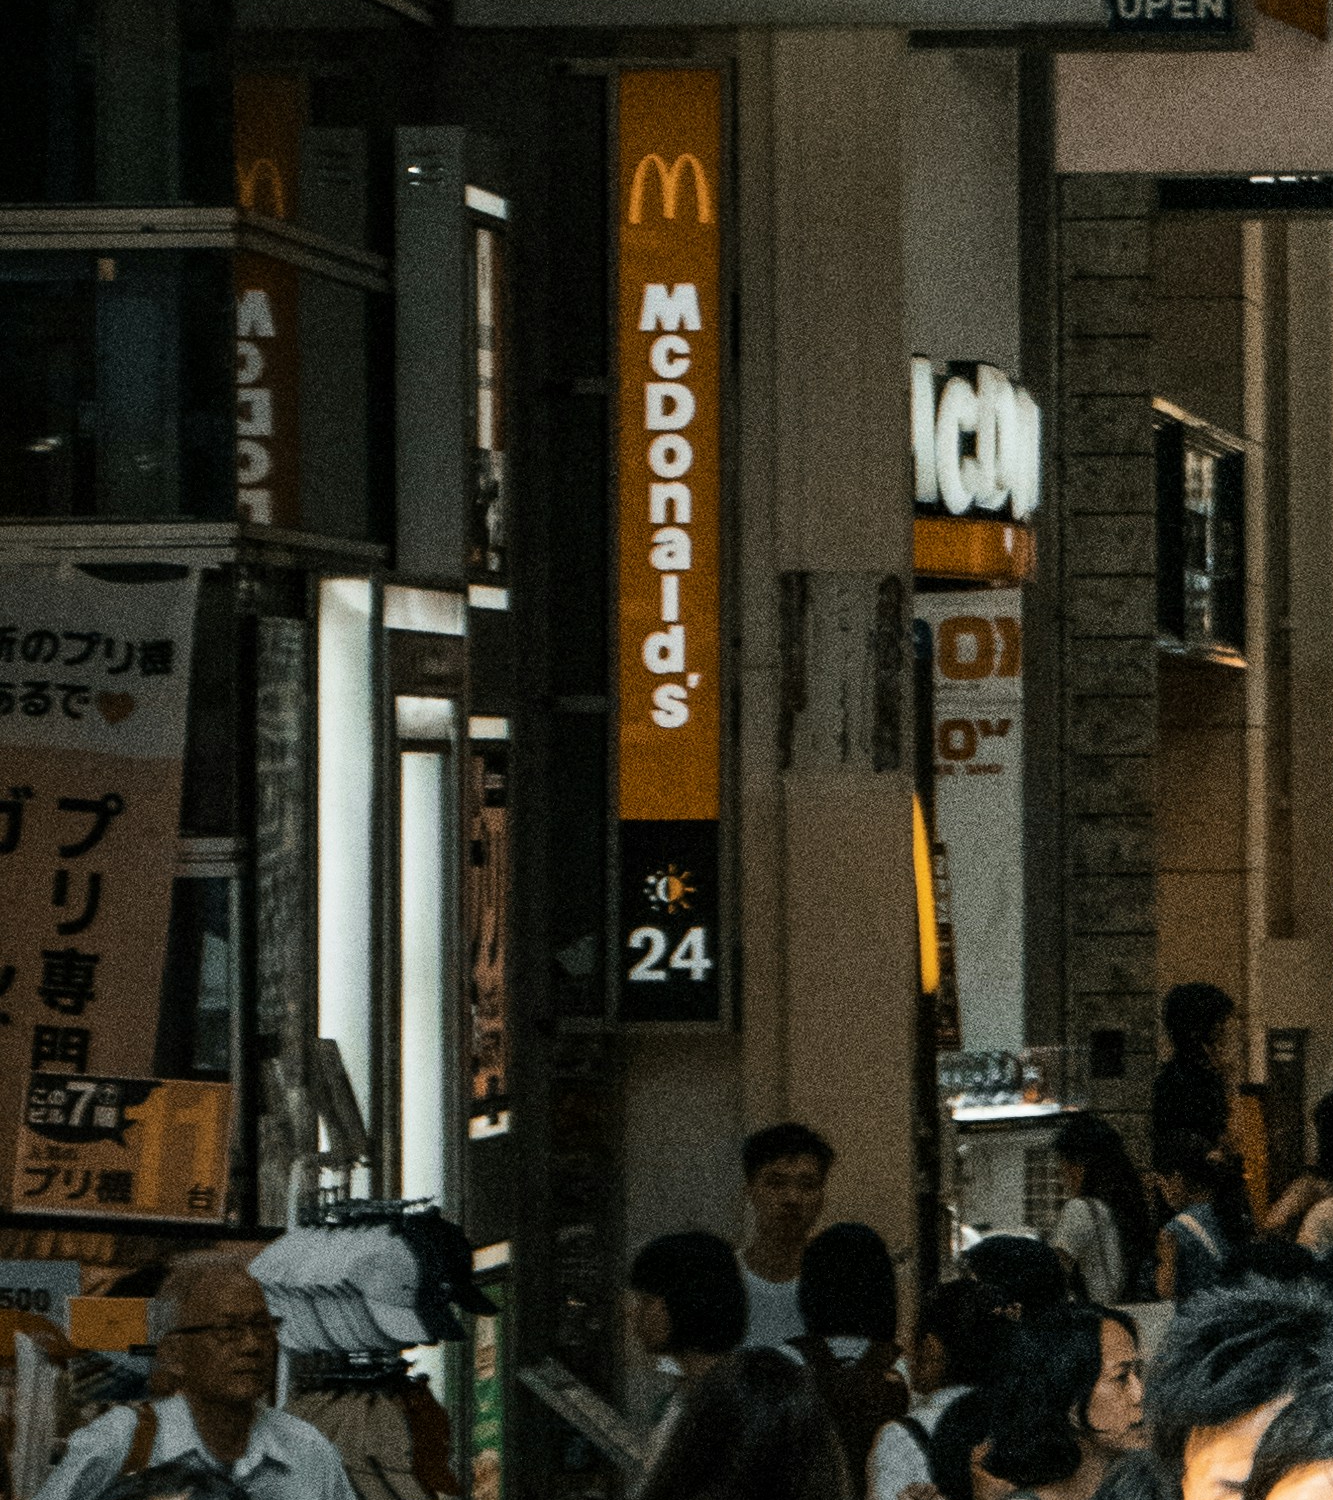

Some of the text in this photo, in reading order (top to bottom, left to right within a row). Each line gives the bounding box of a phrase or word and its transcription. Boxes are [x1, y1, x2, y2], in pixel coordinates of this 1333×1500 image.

[639, 282, 703, 729] McDonald's
[32, 793, 125, 1073] プリ専門
[626, 925, 713, 982] 24
